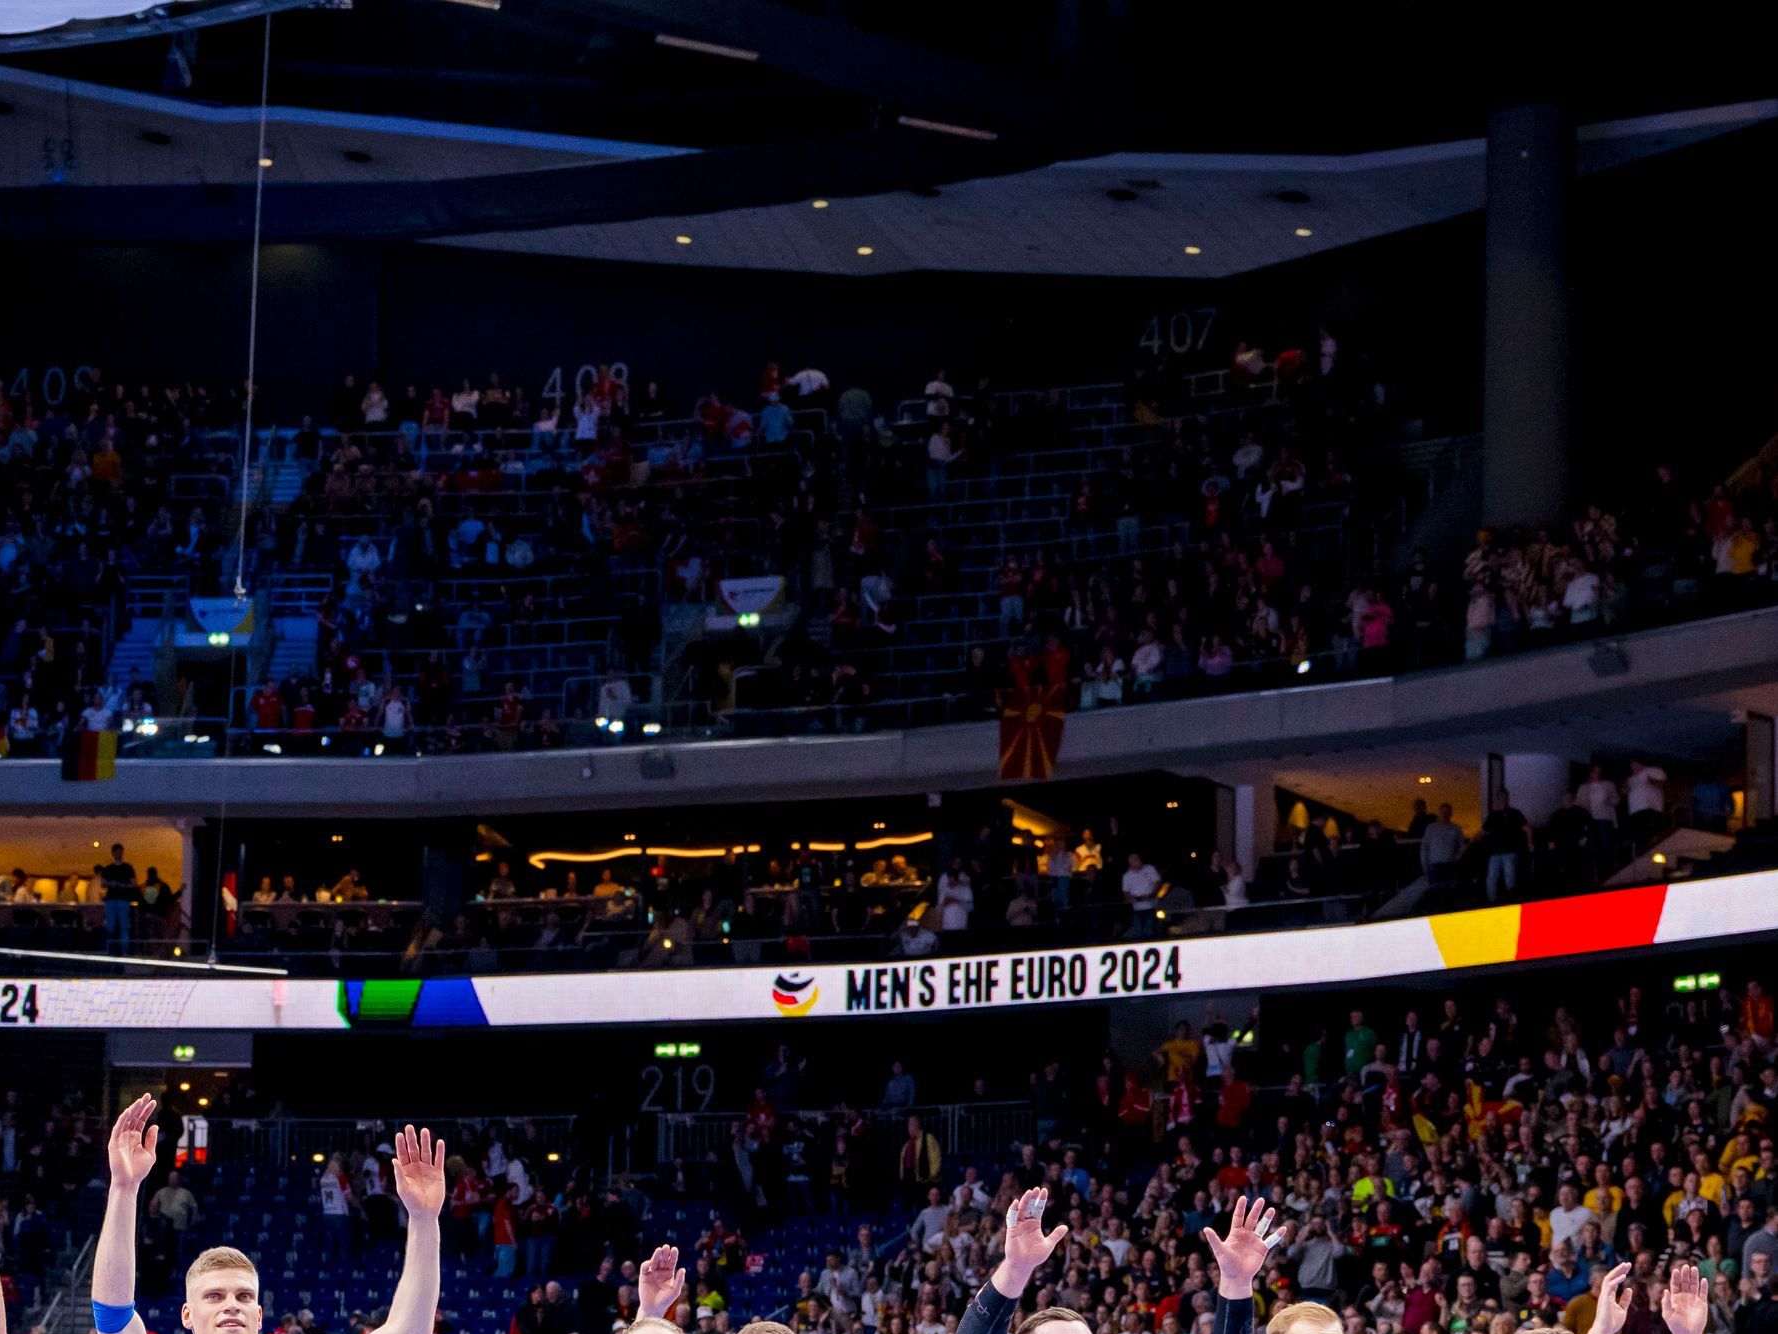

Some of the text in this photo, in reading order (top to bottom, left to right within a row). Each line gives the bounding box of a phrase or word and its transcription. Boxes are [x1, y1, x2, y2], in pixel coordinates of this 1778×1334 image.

[1138, 307, 1217, 356] 407
[846, 945, 1182, 1012] MEN'S EHF EURO 2024
[640, 1063, 716, 1112] 219
